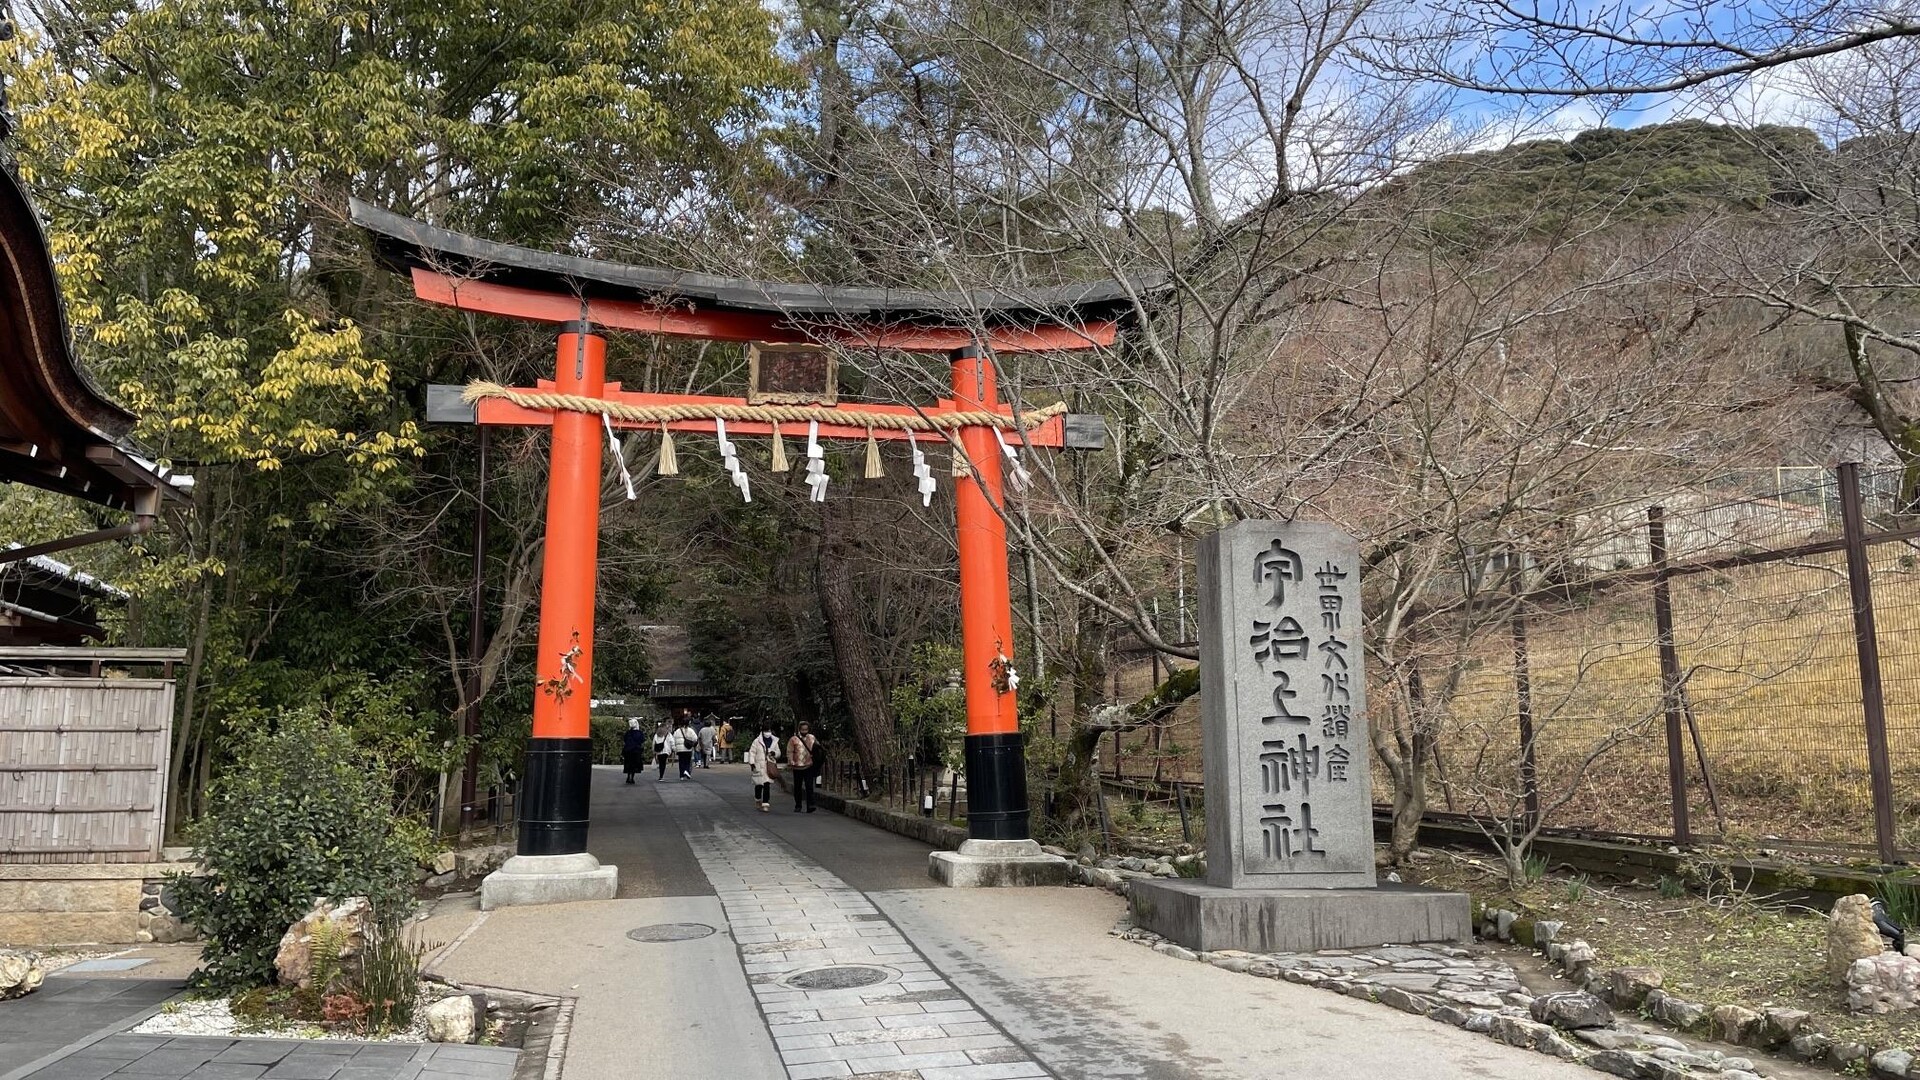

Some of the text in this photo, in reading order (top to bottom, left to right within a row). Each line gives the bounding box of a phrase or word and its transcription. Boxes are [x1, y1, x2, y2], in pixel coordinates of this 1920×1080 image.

[1250, 539, 1326, 860] 宇治上神社
[1314, 561, 1350, 783] 世界文化遺産
